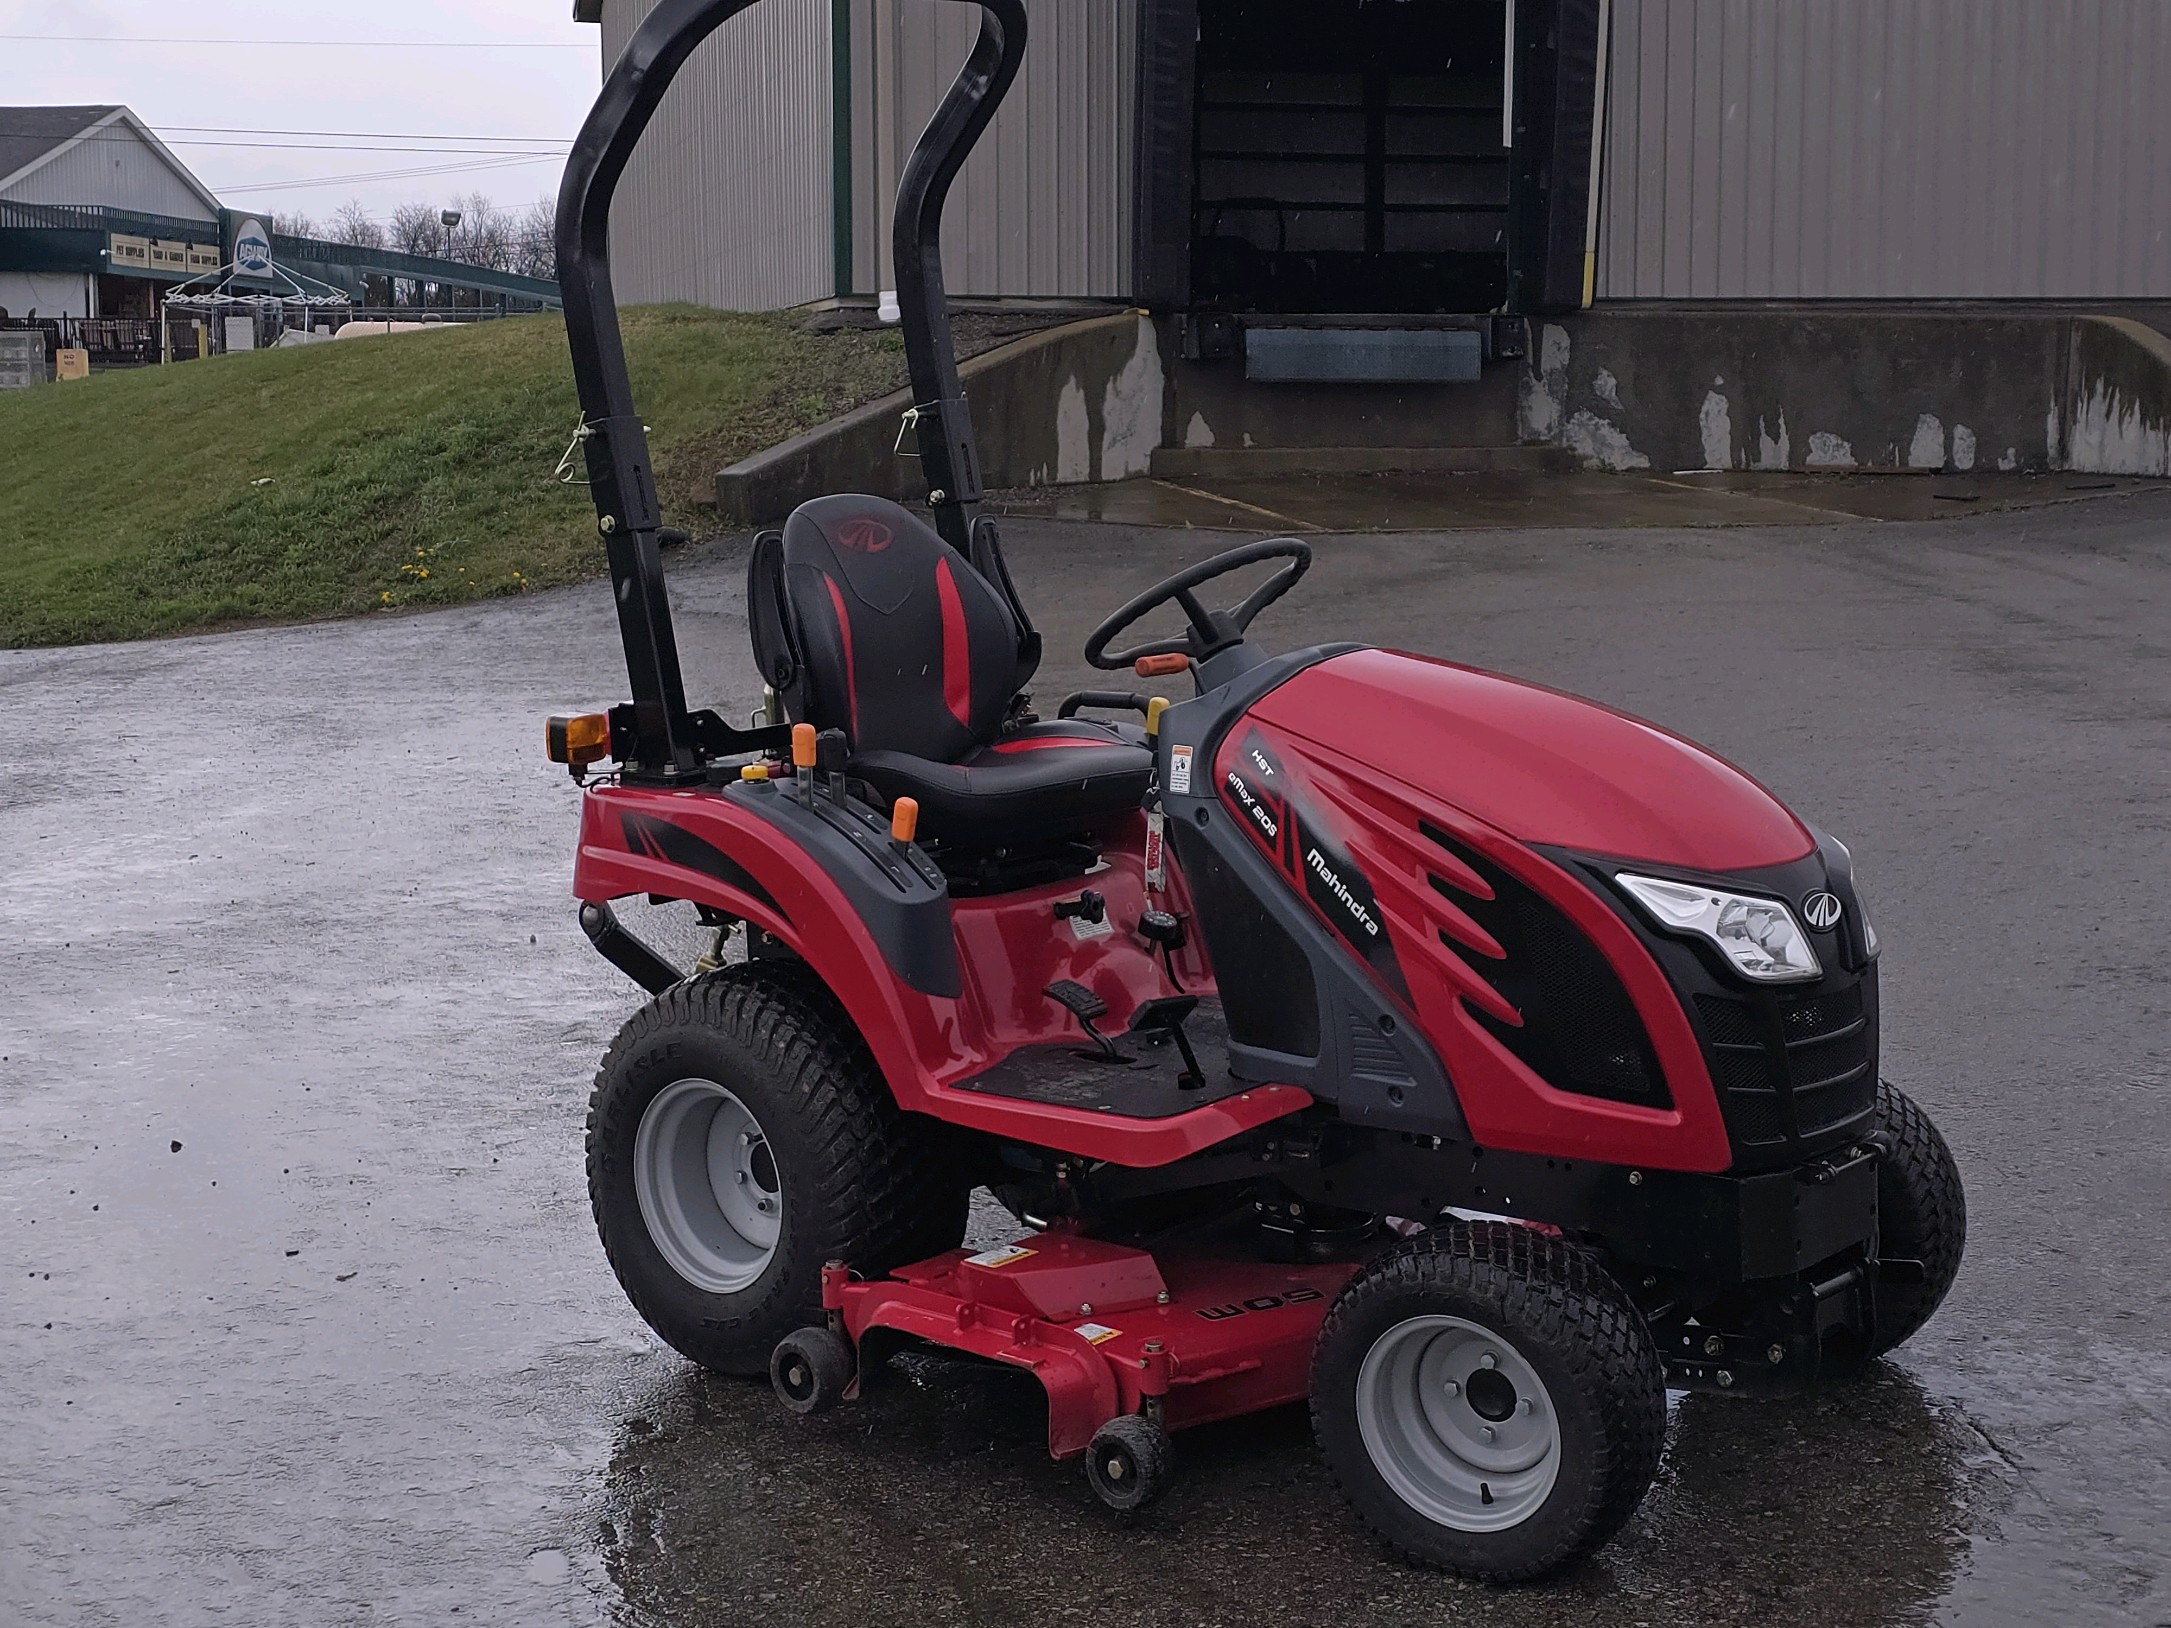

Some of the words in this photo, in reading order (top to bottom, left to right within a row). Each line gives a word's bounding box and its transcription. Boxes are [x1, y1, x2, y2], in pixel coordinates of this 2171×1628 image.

[239, 243, 269, 262] AGWAY
[1251, 749, 1274, 776] HST
[1306, 848, 1379, 936] Mahindra
